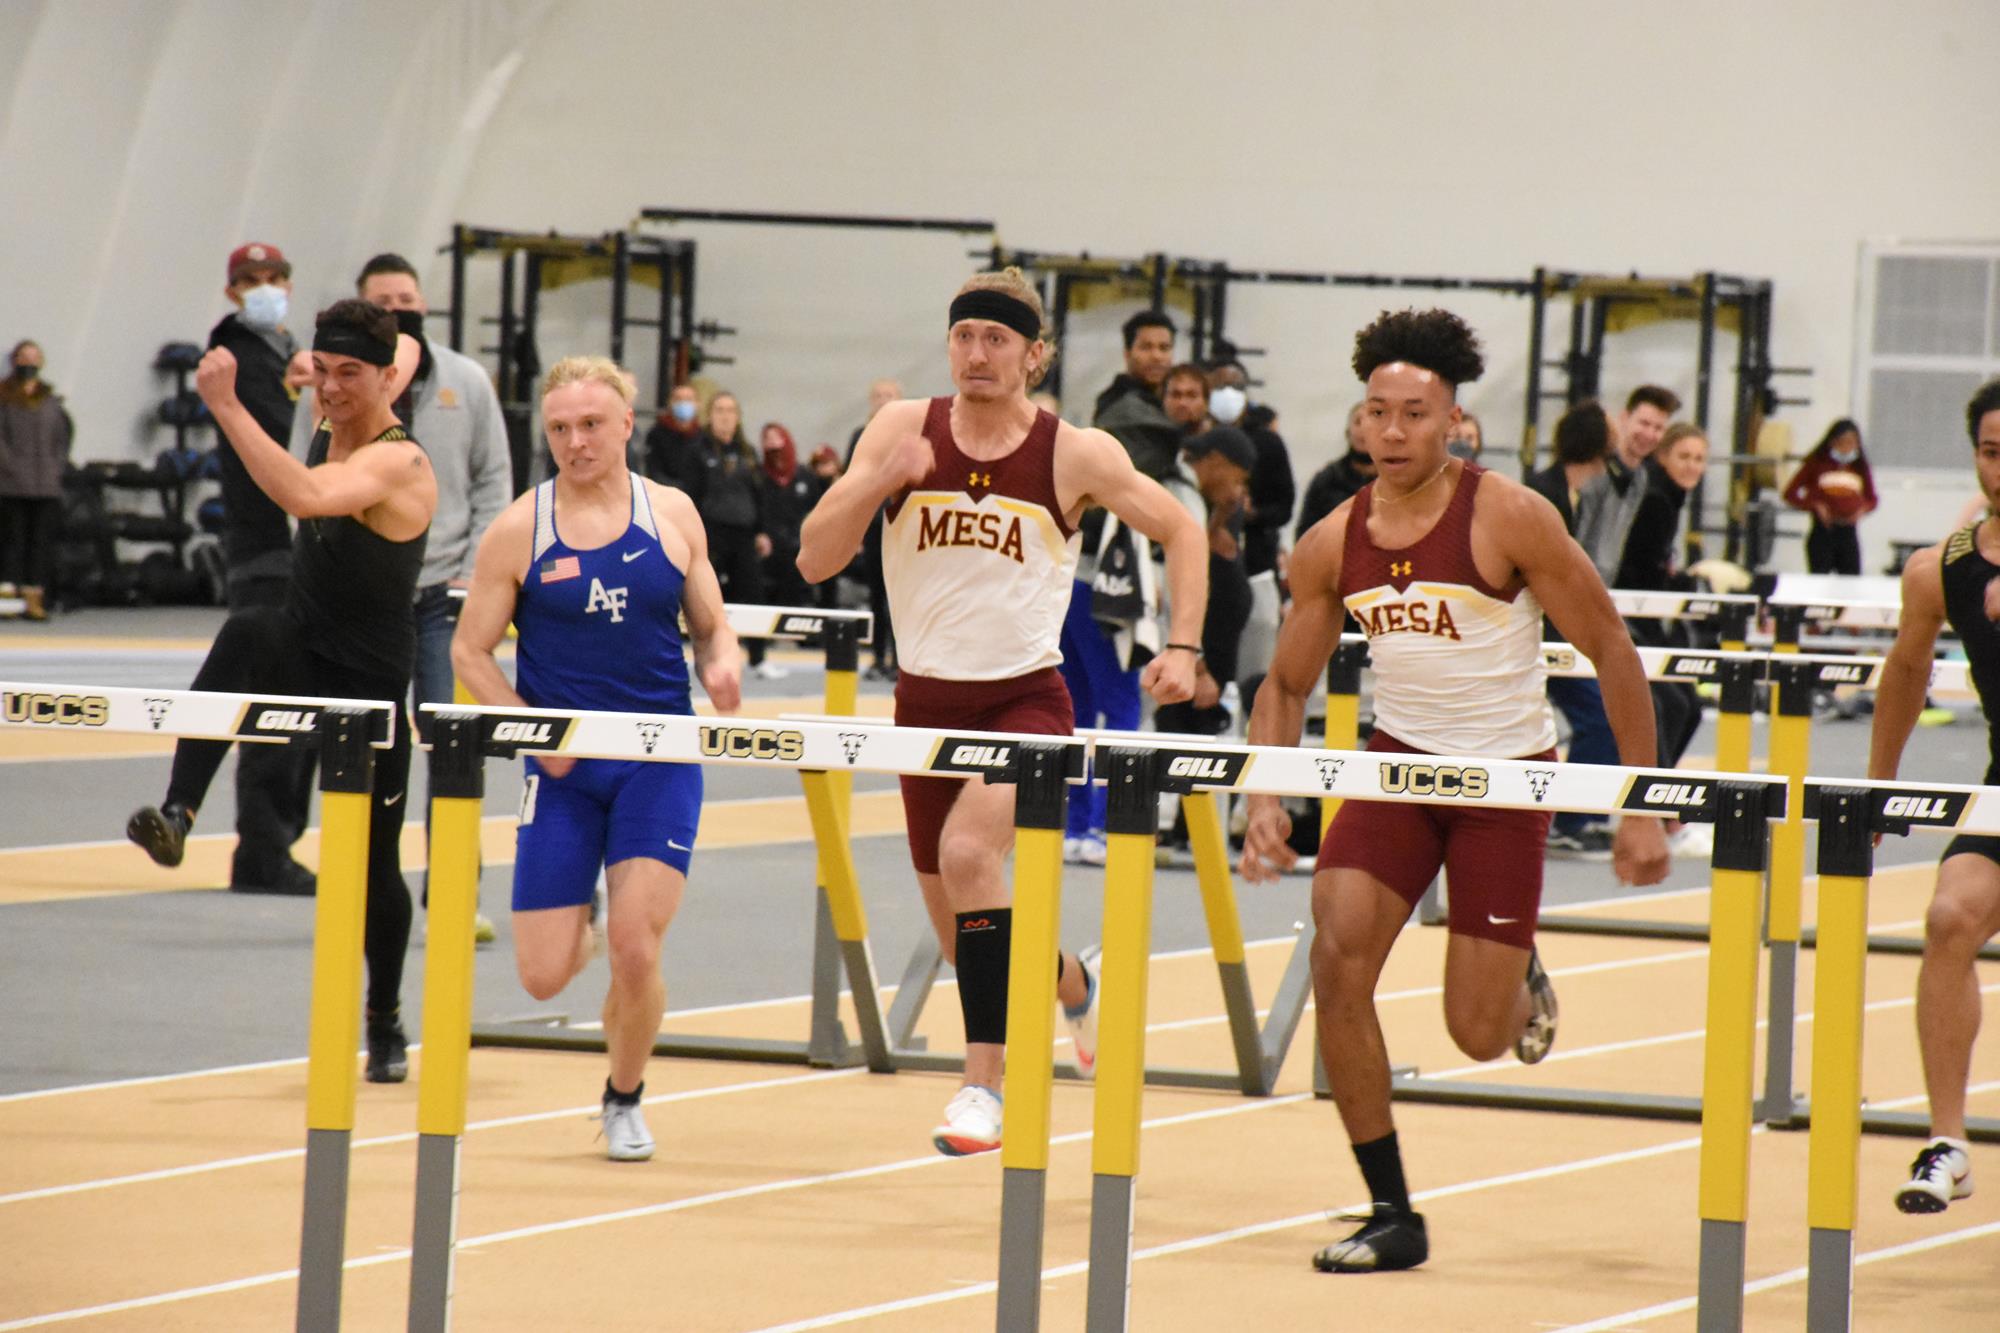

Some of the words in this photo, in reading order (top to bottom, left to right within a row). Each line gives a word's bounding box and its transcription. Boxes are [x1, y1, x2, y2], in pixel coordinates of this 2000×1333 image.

[917, 506, 1024, 563] MESA
[585, 577, 628, 623] AF
[1353, 600, 1461, 641] MESA
[3, 692, 110, 726] UCCS
[255, 710, 317, 731] GILL
[492, 721, 552, 743] GILL
[699, 726, 804, 761] UCCS
[950, 745, 1011, 767] GILL
[1167, 756, 1228, 779] GILL
[1380, 762, 1489, 799] UCCS
[1643, 783, 1707, 806] GILL
[1883, 796, 1948, 819] GILL
